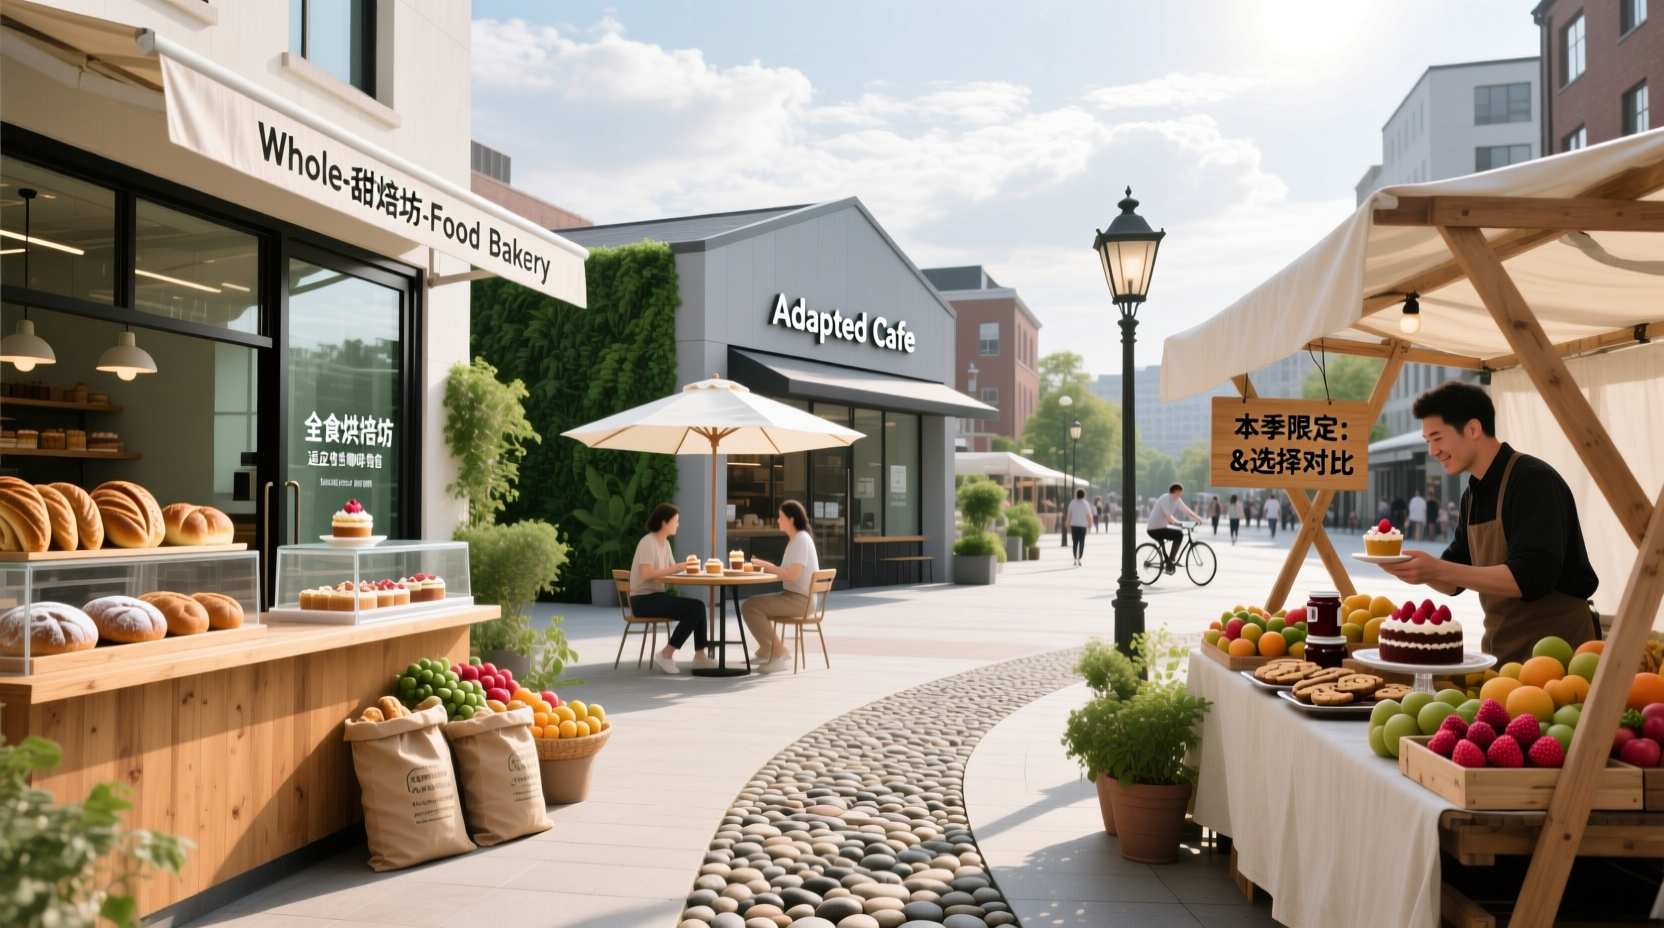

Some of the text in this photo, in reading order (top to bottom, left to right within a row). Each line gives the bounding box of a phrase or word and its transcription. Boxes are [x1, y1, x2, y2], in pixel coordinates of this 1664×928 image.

[489, 227, 550, 285] Bakery
[772, 293, 916, 353] Adapted Cafe
[1230, 447, 1354, 475] &选择对比
